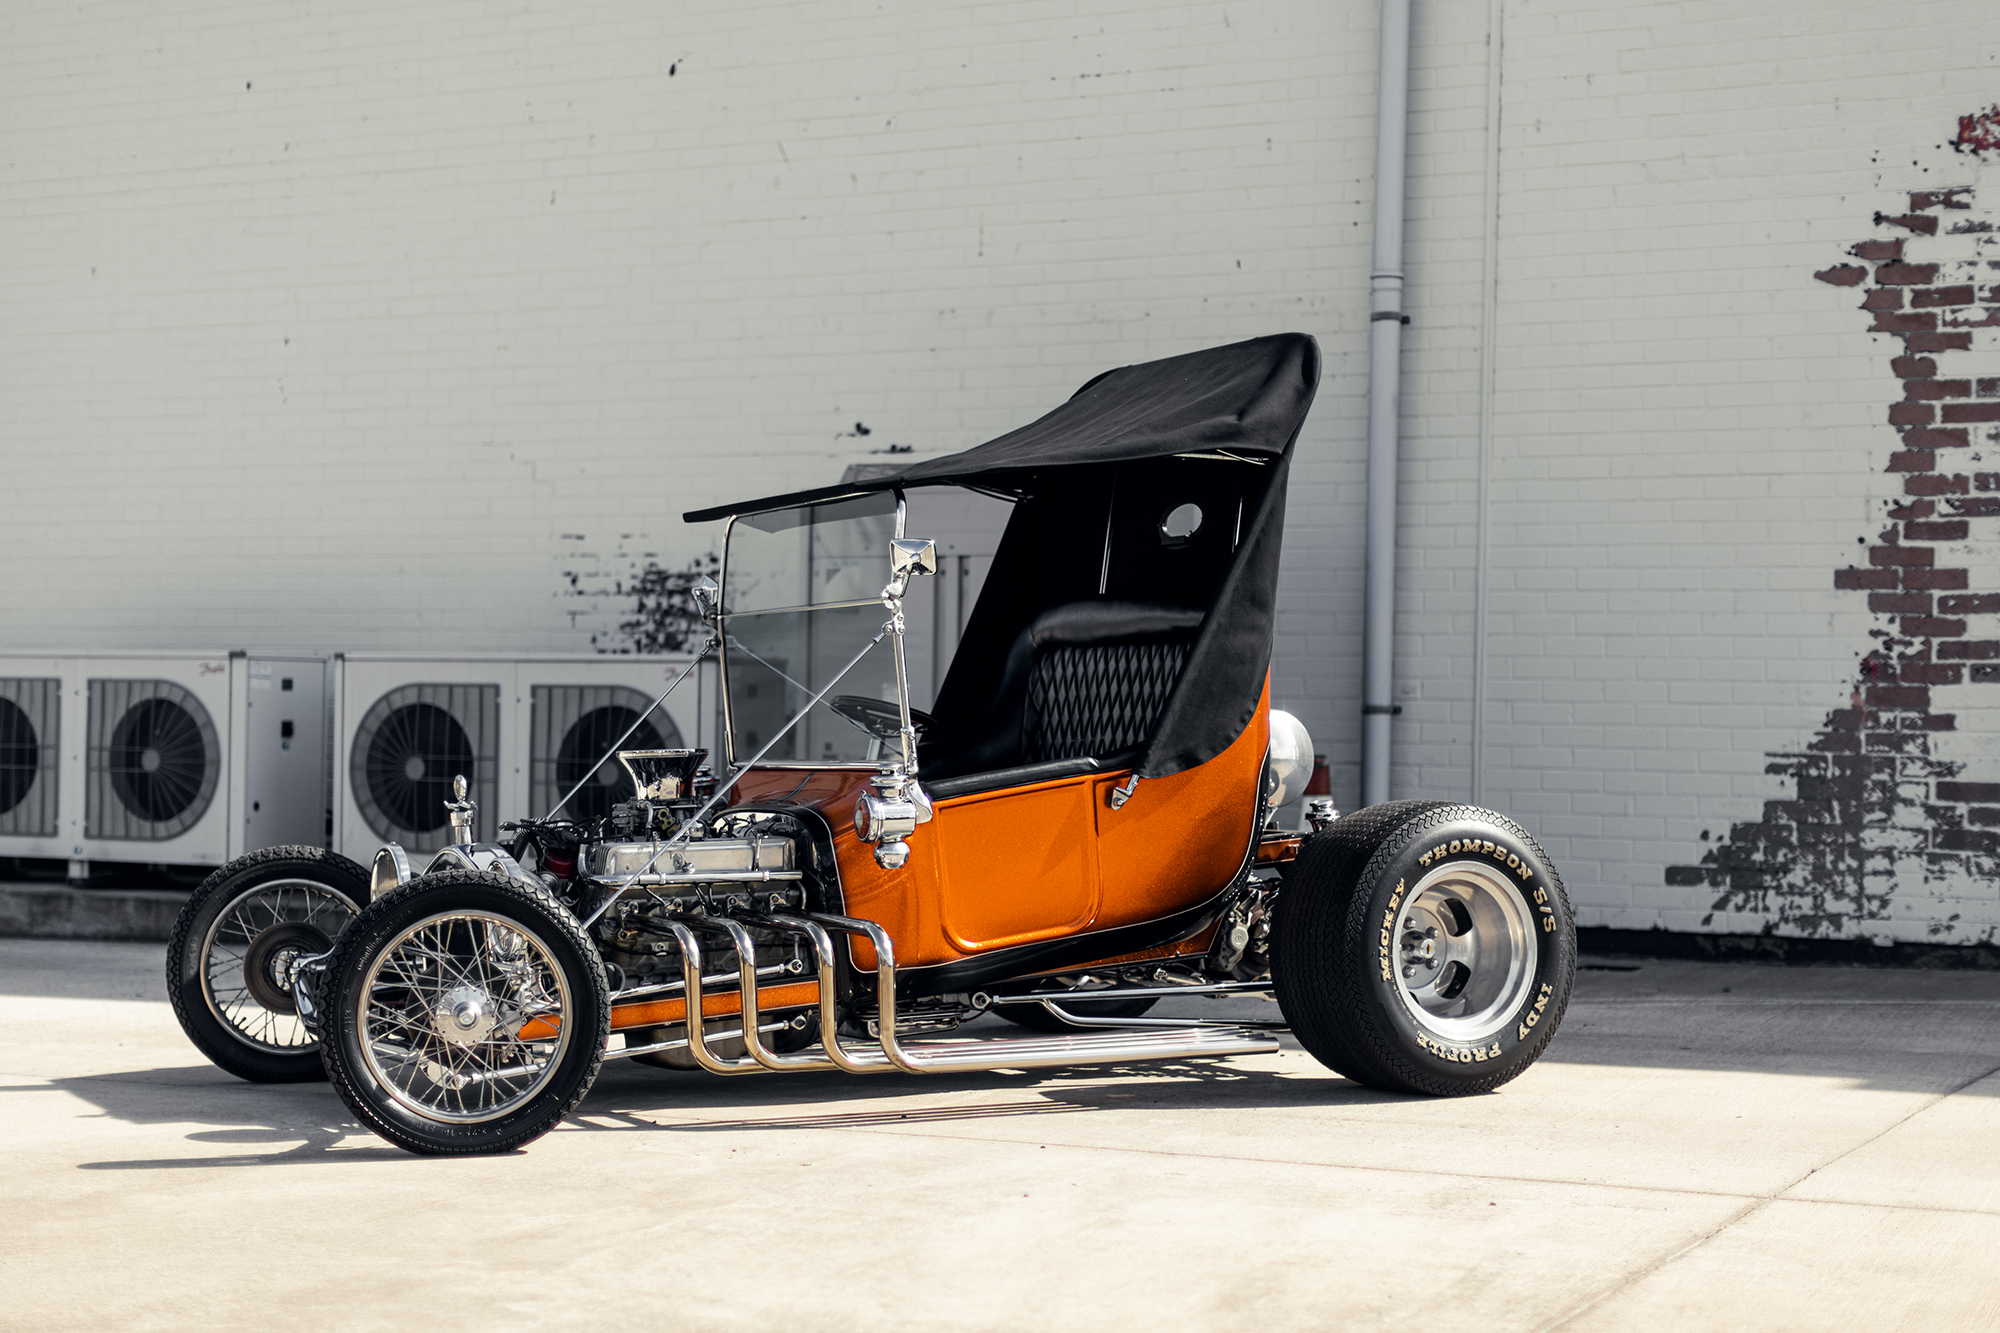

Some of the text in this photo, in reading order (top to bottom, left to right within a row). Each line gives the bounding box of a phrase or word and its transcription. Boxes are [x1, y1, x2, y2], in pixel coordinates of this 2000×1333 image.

[1379, 839, 1556, 982] MICKEY THOMPSON S/S
[1518, 983, 1553, 1040] INDY
[1416, 1030, 1502, 1063] PROFILE
